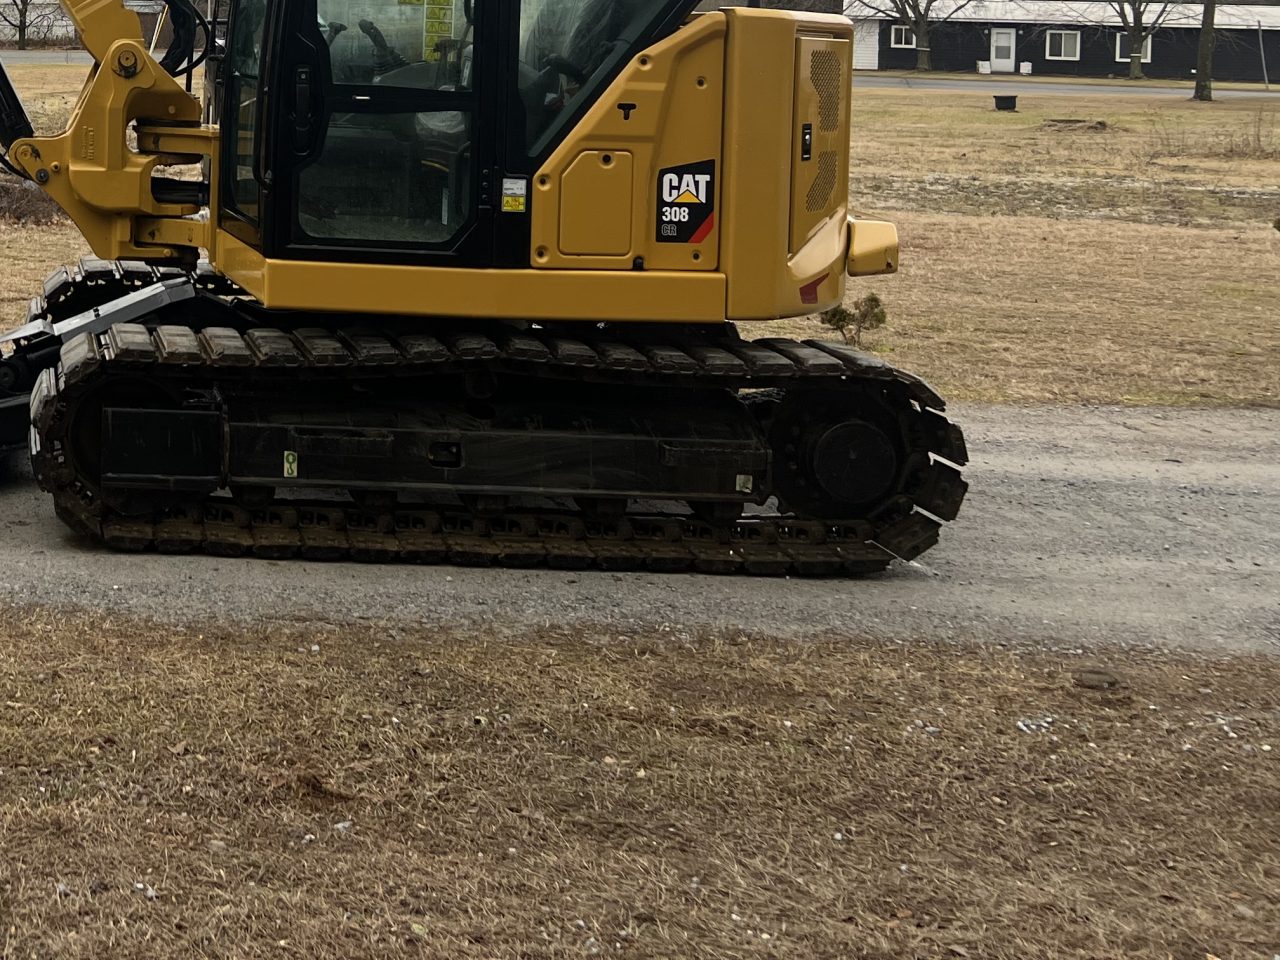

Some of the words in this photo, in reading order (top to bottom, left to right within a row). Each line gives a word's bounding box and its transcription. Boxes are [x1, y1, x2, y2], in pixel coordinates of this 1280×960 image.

[662, 173, 711, 203] CAT
[661, 206, 689, 222] 308
[661, 224, 677, 236] CR
